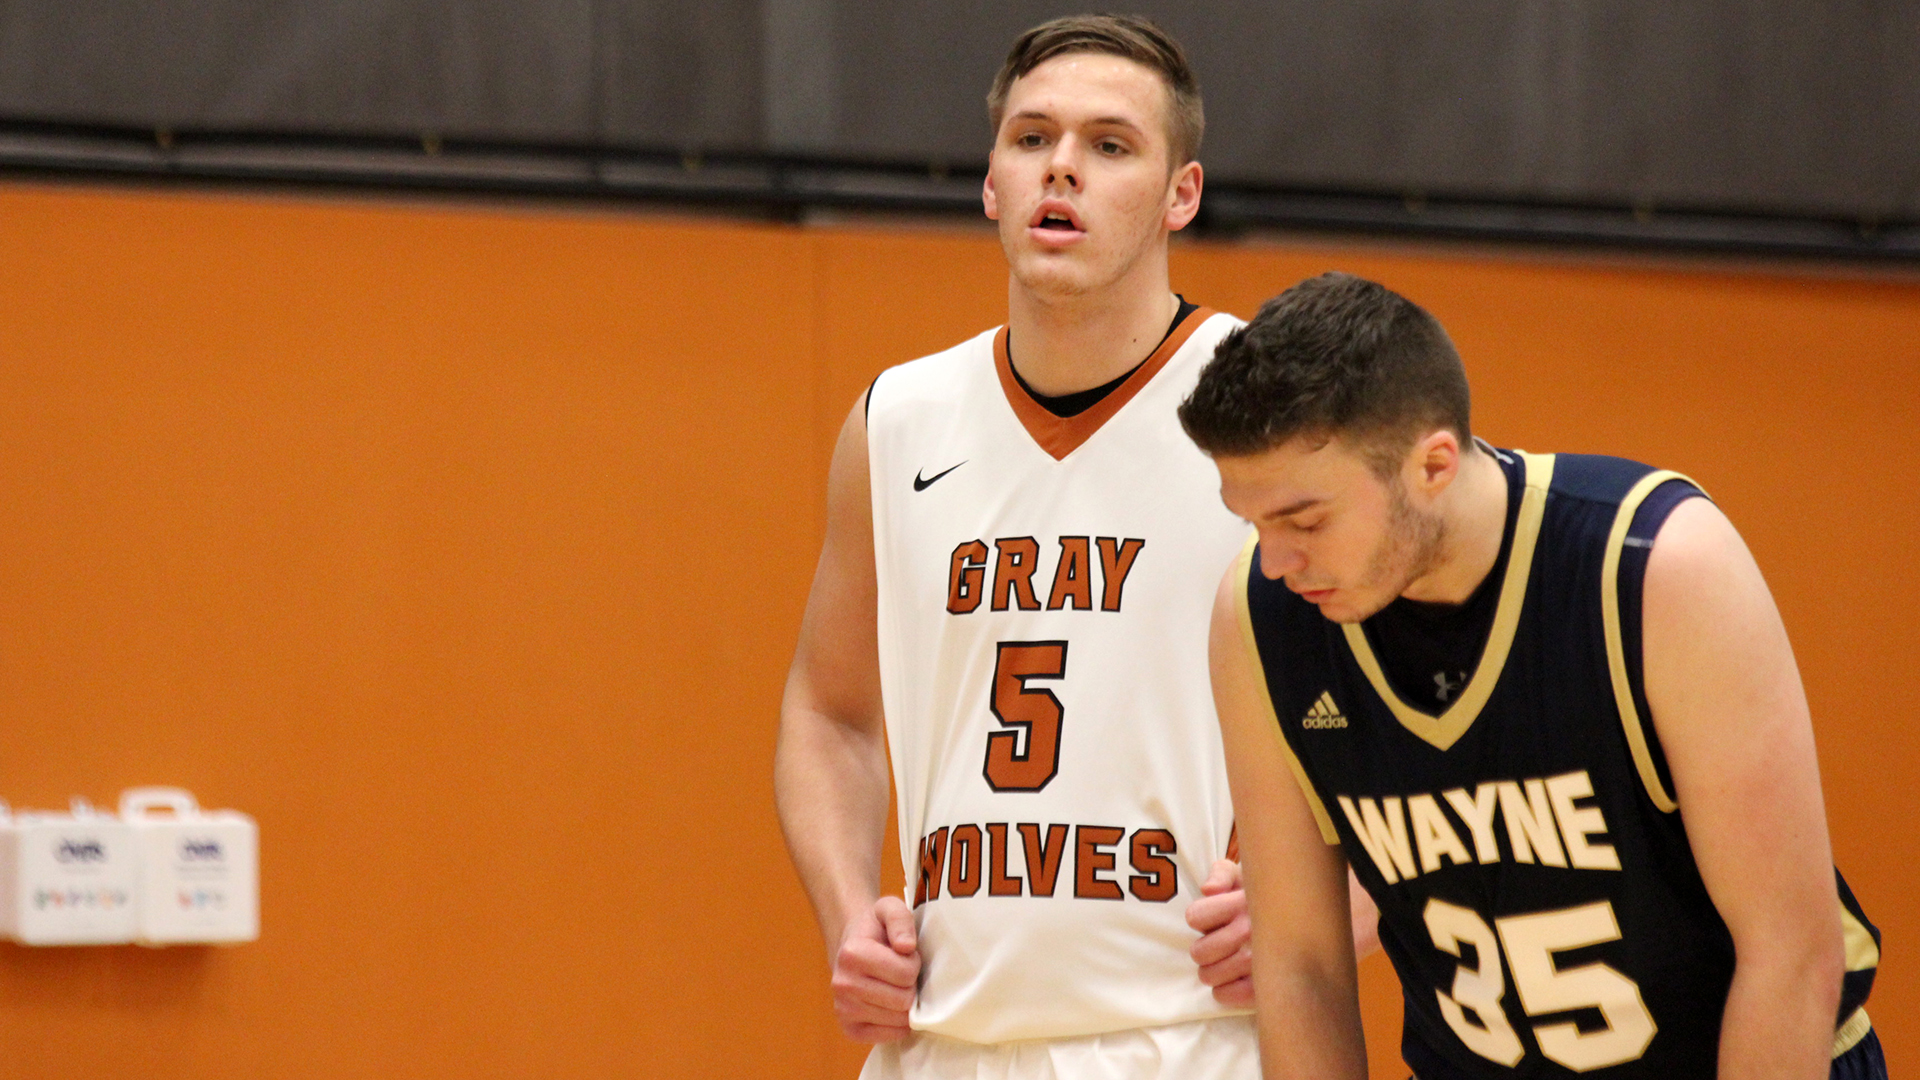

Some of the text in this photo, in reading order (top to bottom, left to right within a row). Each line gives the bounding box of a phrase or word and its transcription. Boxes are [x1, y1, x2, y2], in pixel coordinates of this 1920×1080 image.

[946, 535, 1146, 615] GRAY
[982, 640, 1069, 793] 5
[1302, 714, 1348, 730] adidas
[913, 822, 1178, 909] WOLVES
[1337, 770, 1623, 886] WAYNE
[1422, 898, 1659, 1073] 35
